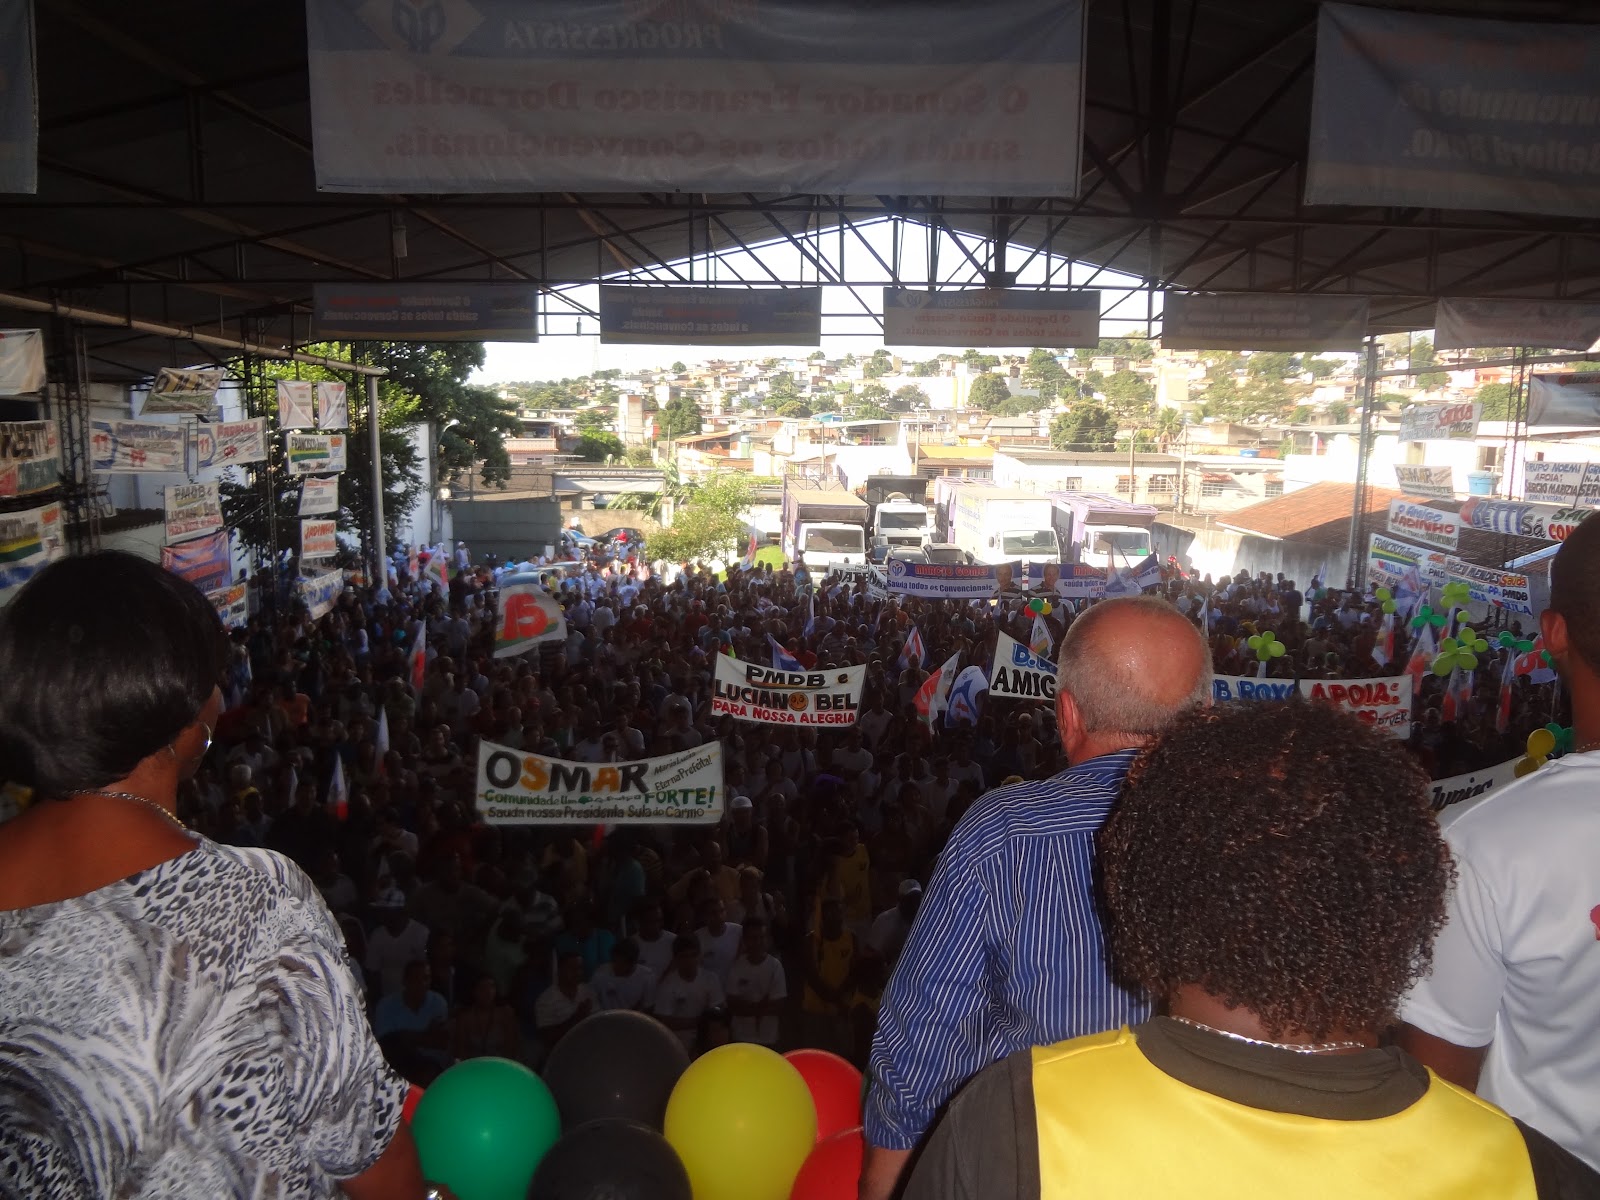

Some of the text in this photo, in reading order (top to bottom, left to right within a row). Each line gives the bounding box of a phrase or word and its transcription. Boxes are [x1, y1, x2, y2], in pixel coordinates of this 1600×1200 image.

[1391, 512, 1455, 535] JADINHO
[1502, 588, 1528, 601] PMDB
[745, 664, 826, 687] PMDB
[991, 665, 1057, 699] AMIG
[712, 699, 856, 724] PARA NOSSA ALEGRIA
[814, 692, 858, 711] BEL
[485, 750, 652, 795] OSMAR
[484, 788, 560, 806] Comunidade
[644, 786, 717, 809] FORTE!
[526, 808, 564, 819] nossa
[652, 808, 665, 816] do
[664, 805, 706, 820] Carmo
